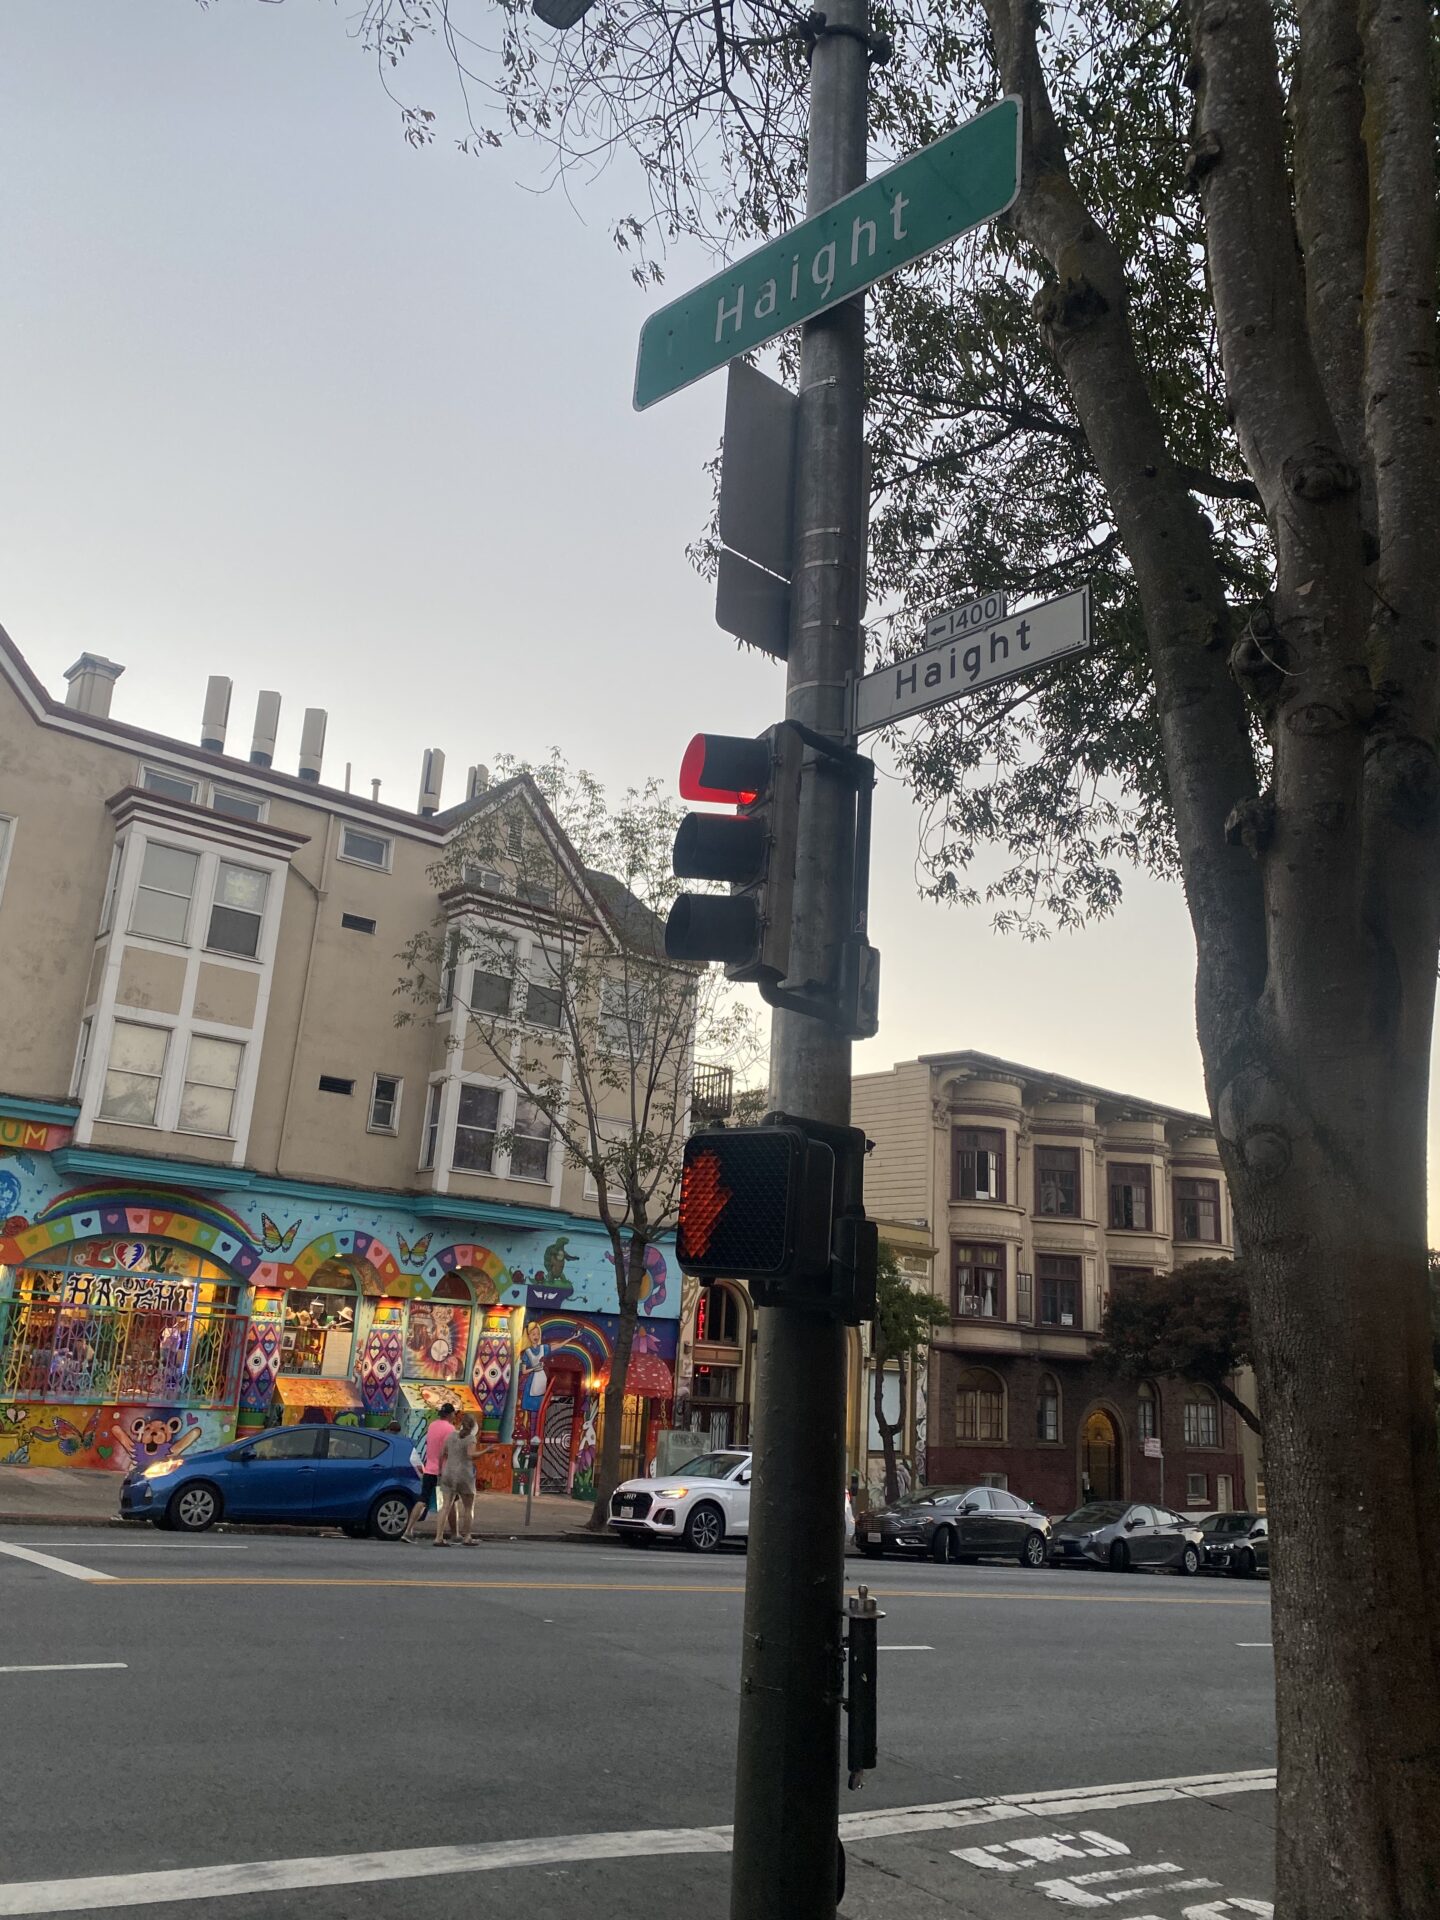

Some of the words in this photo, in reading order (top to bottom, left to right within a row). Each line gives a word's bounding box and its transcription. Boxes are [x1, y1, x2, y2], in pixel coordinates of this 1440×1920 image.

[715, 192, 909, 343] Haight
[950, 597, 998, 634] 1400
[896, 619, 1031, 699] Haight
[2, 1120, 47, 1145] UM
[68, 1275, 193, 1314] HAIGHT
